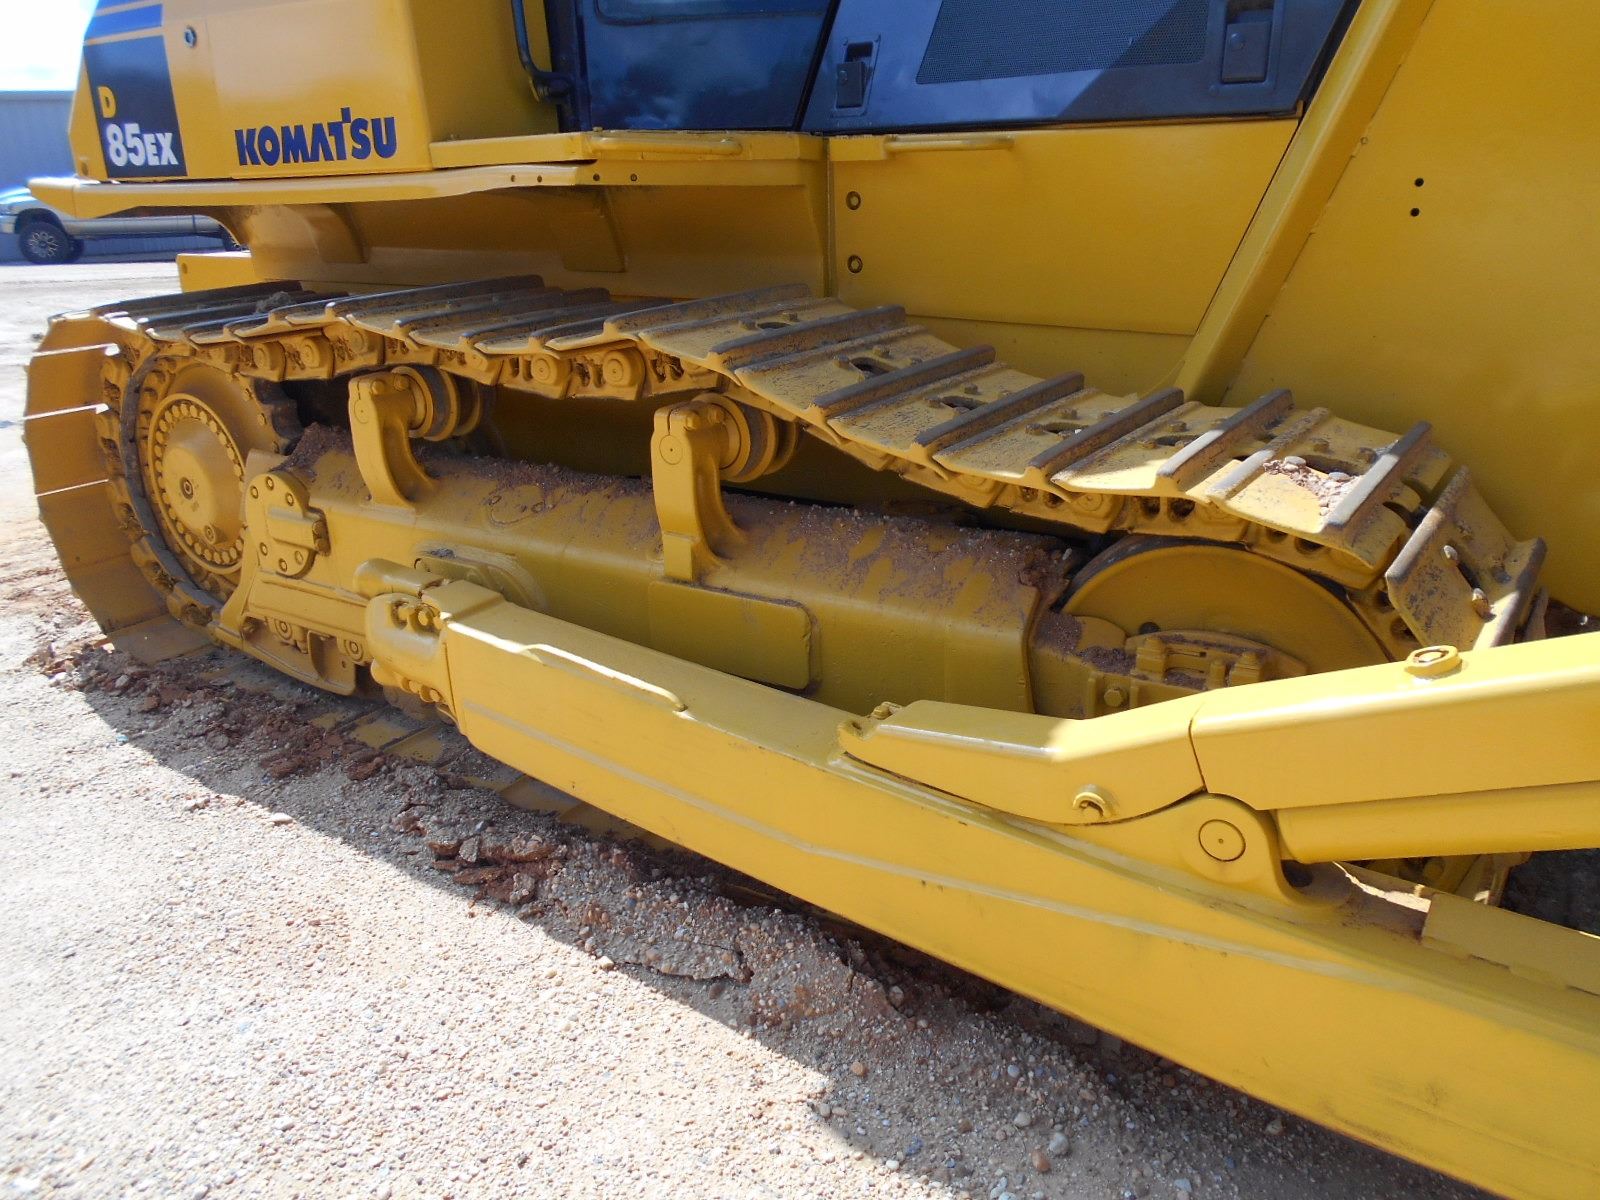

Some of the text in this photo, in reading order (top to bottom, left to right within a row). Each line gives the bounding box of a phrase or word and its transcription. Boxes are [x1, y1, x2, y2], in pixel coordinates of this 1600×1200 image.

[97, 86, 117, 118] D
[105, 122, 179, 168] 85EX
[234, 107, 397, 167] KOMATSU
